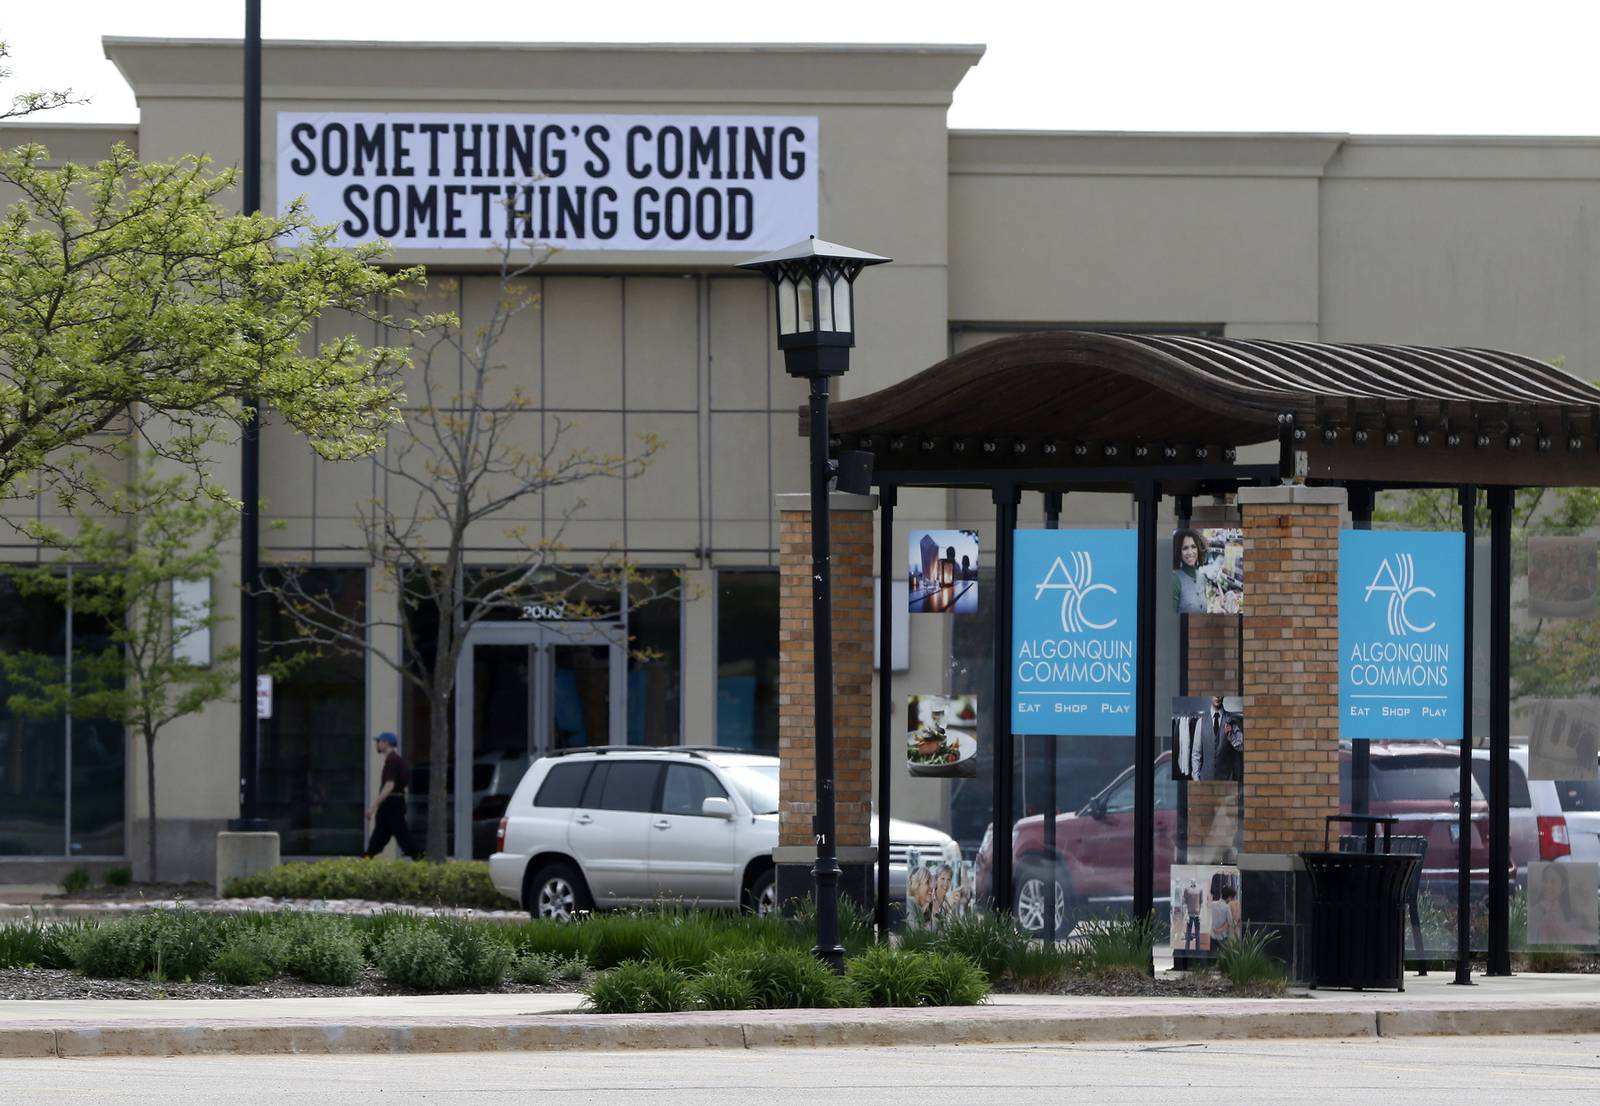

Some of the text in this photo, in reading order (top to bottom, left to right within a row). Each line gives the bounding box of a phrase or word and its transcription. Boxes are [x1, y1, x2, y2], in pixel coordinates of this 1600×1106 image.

[290, 121, 807, 180] SOMETHING'S COMING
[342, 183, 755, 240] SOMETHING GOOD
[1018, 639, 1132, 660] ALGONQUIN
[1350, 642, 1449, 663] ALGONQUIN
[1018, 661, 1131, 683] COMMONS
[1350, 664, 1448, 687] COMMONS
